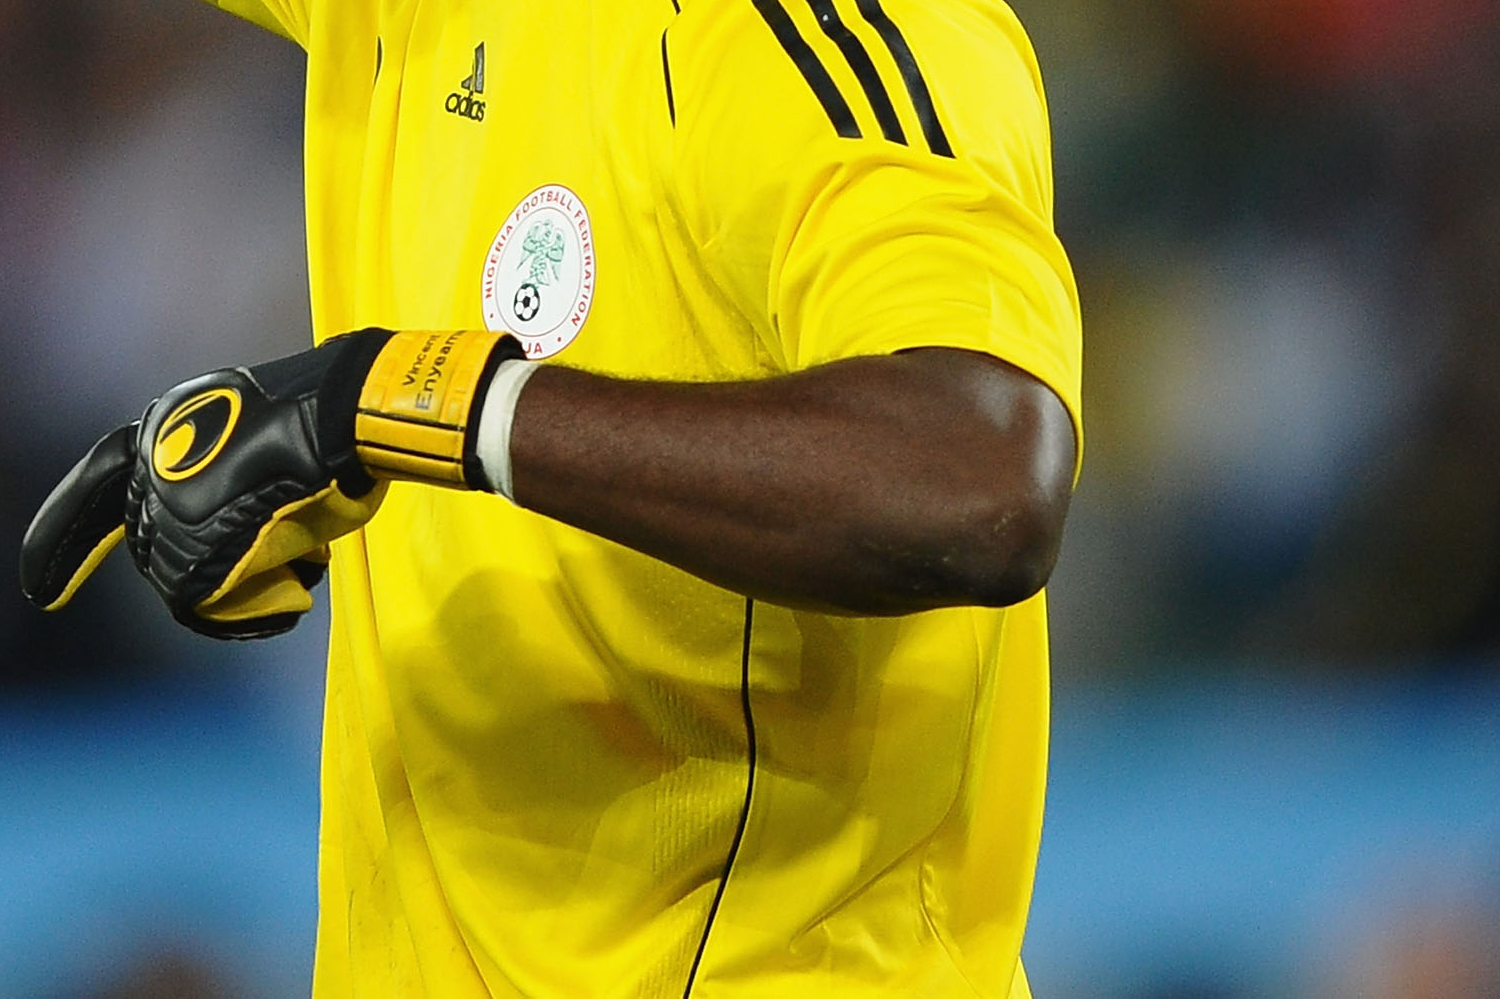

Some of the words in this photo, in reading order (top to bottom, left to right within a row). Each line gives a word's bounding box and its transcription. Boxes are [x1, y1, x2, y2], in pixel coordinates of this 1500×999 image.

[485, 224, 513, 299] NIGERIA
[515, 190, 572, 221] FOOTBALL
[571, 209, 592, 326] FEDERATION
[414, 330, 468, 410] Enyeam
